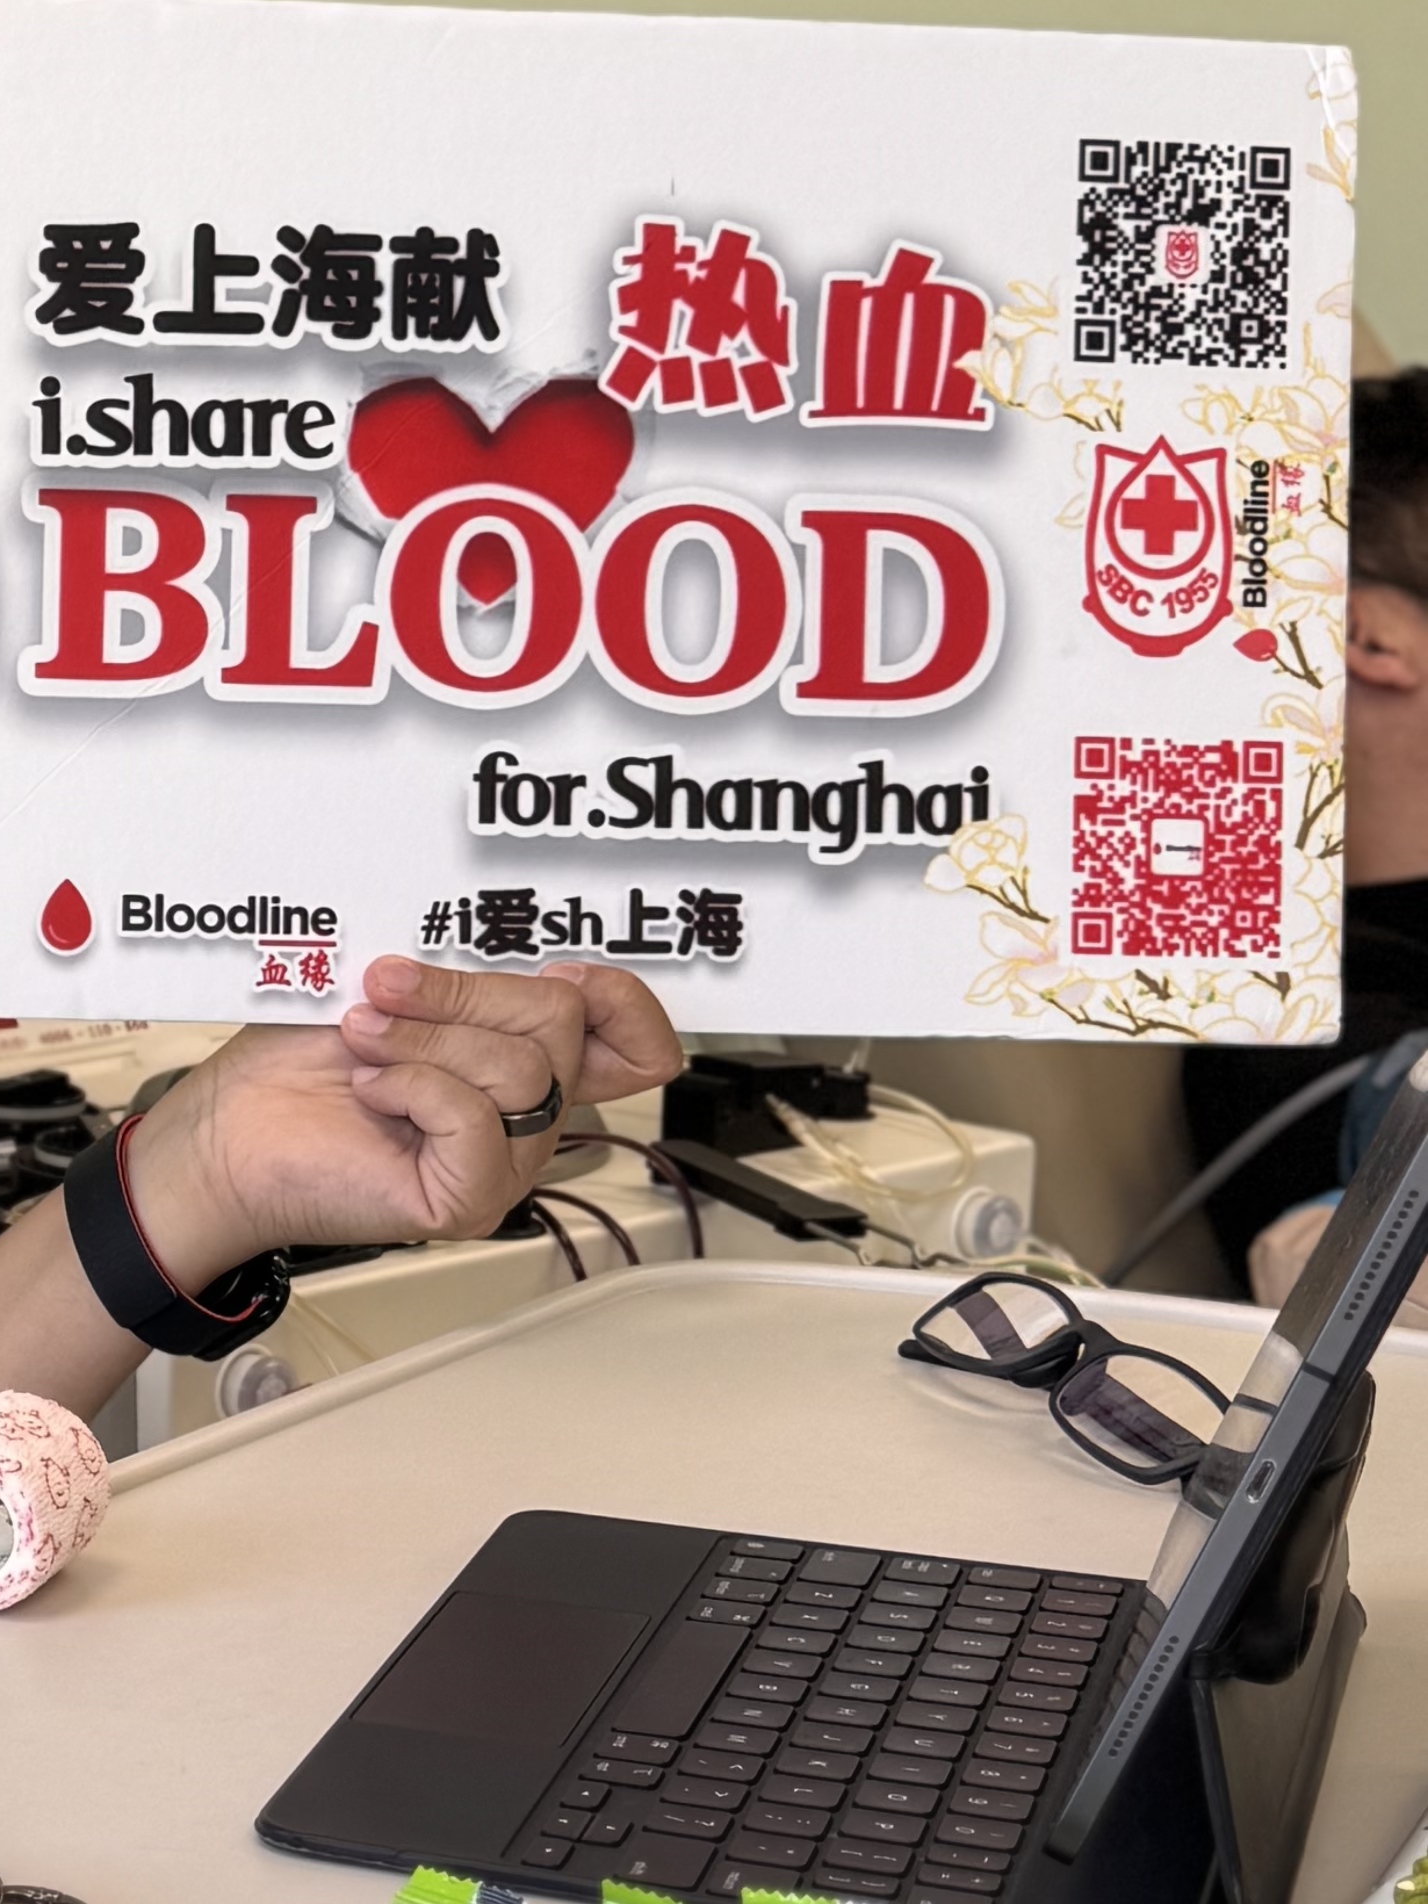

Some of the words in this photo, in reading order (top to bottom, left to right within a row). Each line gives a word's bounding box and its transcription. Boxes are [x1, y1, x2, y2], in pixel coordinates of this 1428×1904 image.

[35, 222, 500, 342] 爱上海献
[599, 222, 989, 424] 热血
[35, 374, 336, 458] i.share
[1242, 459, 1270, 608] Bloodline
[34, 489, 991, 702] BLOOD
[1096, 563, 1154, 617] SBC
[1160, 567, 1219, 619] 1955
[472, 751, 991, 855] for.Shanghai
[121, 893, 338, 936] Bloodline
